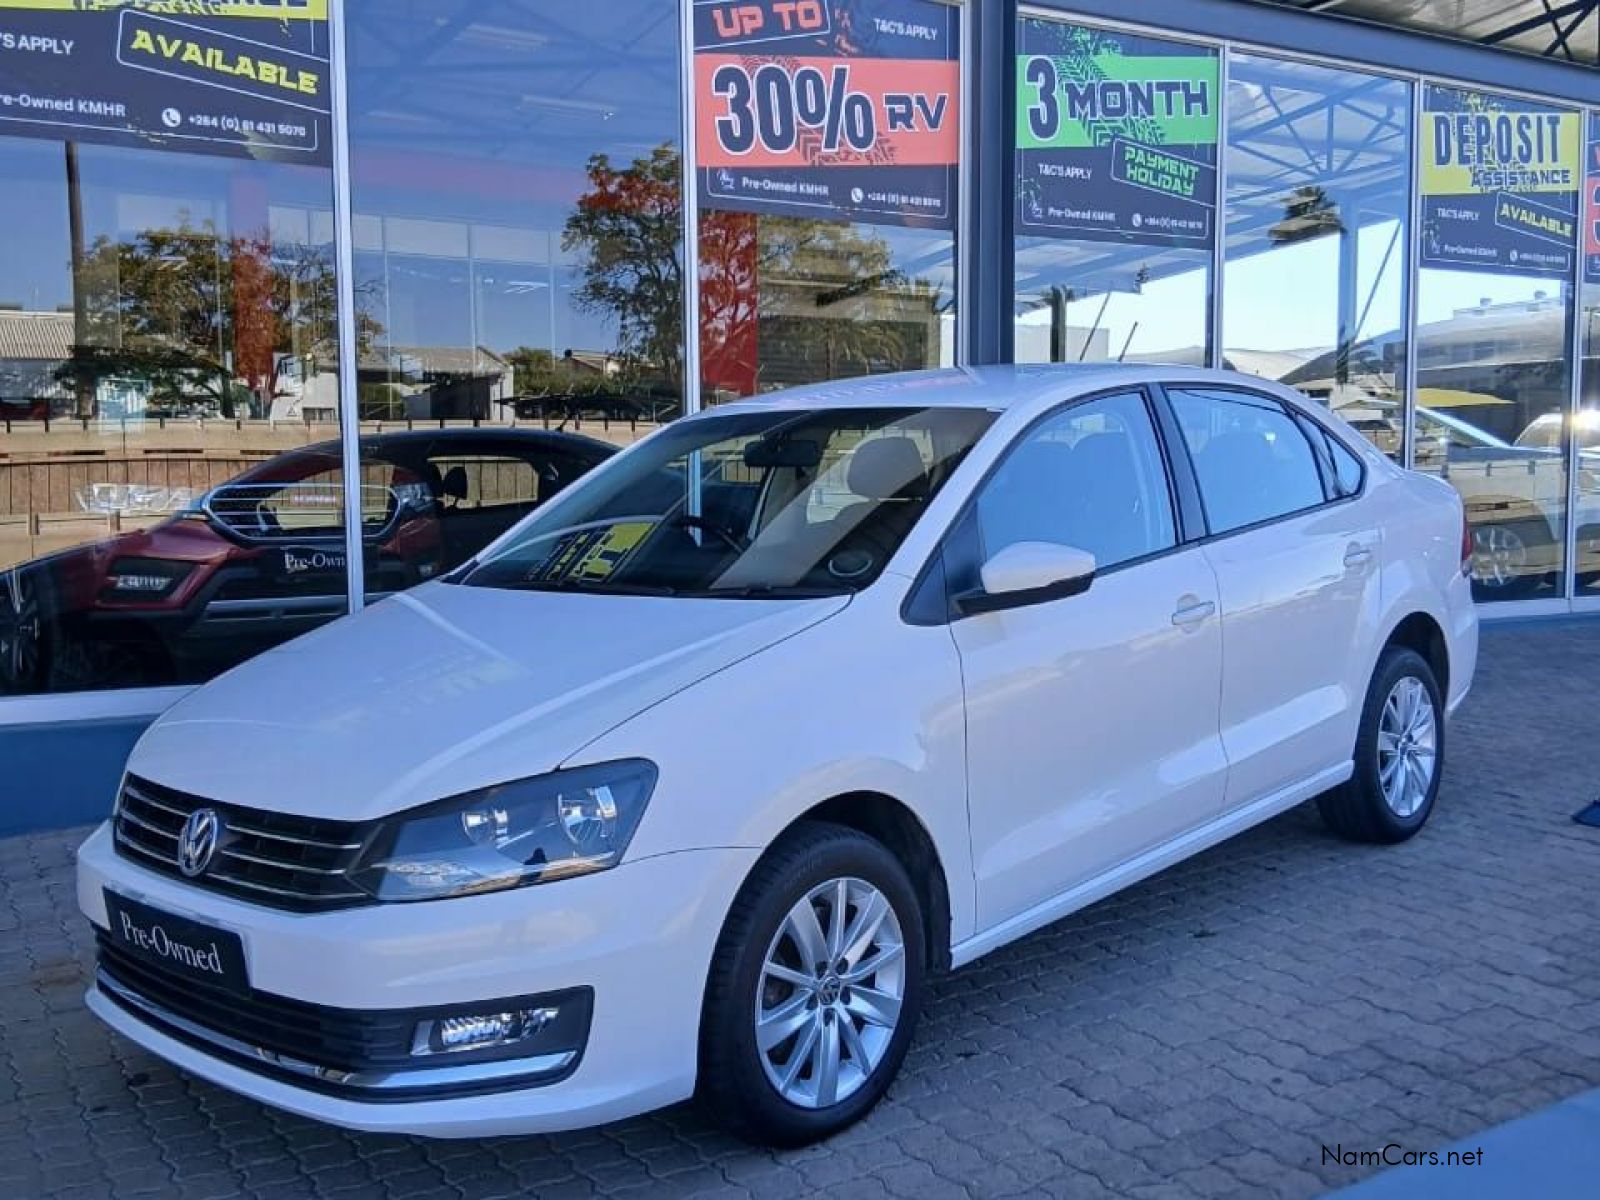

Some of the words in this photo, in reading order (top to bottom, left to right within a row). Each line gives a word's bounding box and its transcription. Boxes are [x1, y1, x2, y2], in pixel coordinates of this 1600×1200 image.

[712, 6, 764, 37] UP
[773, 1, 822, 30] TO
[18, 35, 74, 55] APPLY
[131, 29, 319, 94] AVAILABLE
[78, 100, 126, 117] KMHR
[713, 64, 876, 155] 30%
[884, 93, 948, 132] RV
[1025, 55, 1061, 141] 3
[1063, 80, 1209, 120] MONTH
[1434, 115, 1560, 166] DEPOSIT
[1125, 146, 1199, 180] PAYMENT
[1126, 163, 1194, 196] HOLIDAY
[1471, 169, 1571, 187] ASSISTANCE
[1500, 203, 1573, 238] AVAILABLE
[119, 910, 223, 975] Pre-Owned
